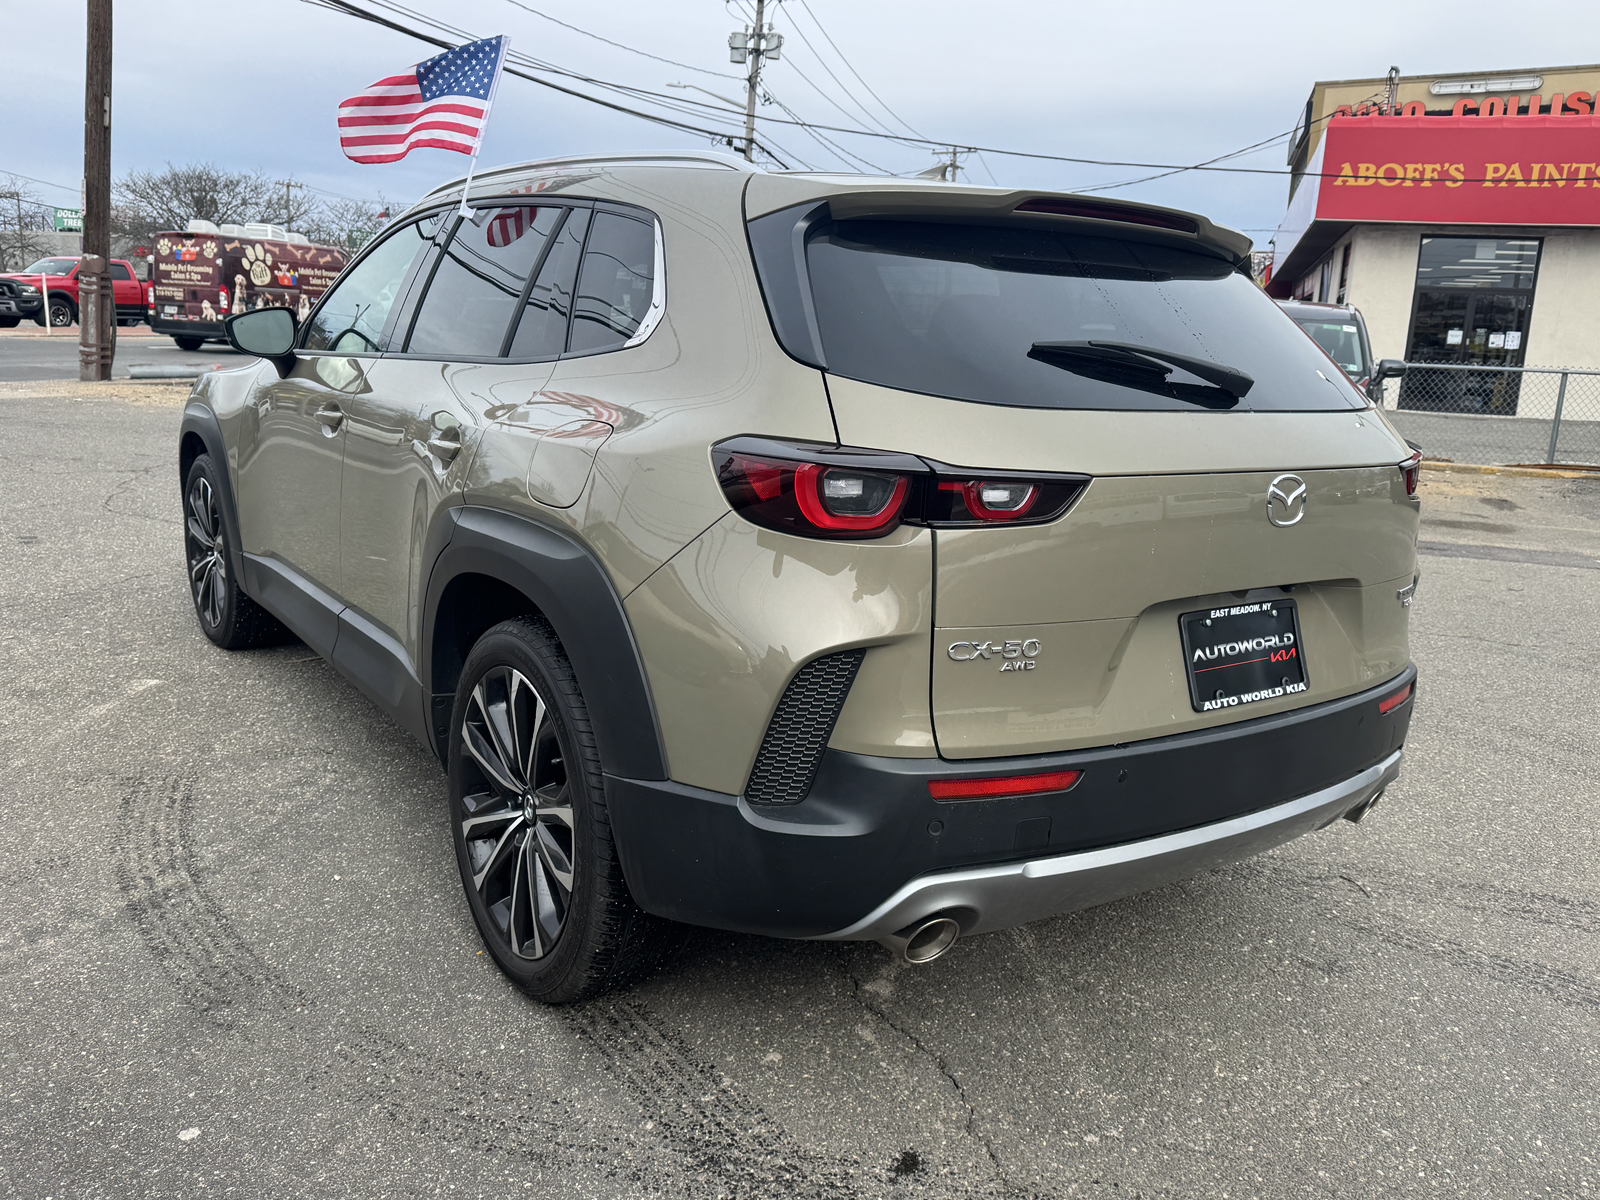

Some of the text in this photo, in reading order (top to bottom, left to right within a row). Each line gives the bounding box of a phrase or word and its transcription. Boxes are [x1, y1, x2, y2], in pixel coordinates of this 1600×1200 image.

[1333, 162, 1465, 188] ABOFF'S
[57, 210, 83, 218] DOLLA
[63, 218, 83, 227] TREE
[159, 262, 213, 275] Mobile Pet Grooming
[251, 265, 269, 281] Ruff
[298, 266, 315, 276] Mobile
[314, 268, 322, 277] Pet
[171, 270, 186, 280] Salon
[191, 272, 202, 282] Spa
[309, 276, 322, 285] Salon
[1211, 608, 1229, 619] EAST
[1262, 602, 1272, 611] NY
[947, 638, 1043, 662] CX-50
[1192, 632, 1294, 663] AUTOWORLD
[1270, 647, 1297, 663] KIA
[1000, 660, 1037, 673] AWD
[1203, 682, 1307, 711] AUTO WORLD KIA
